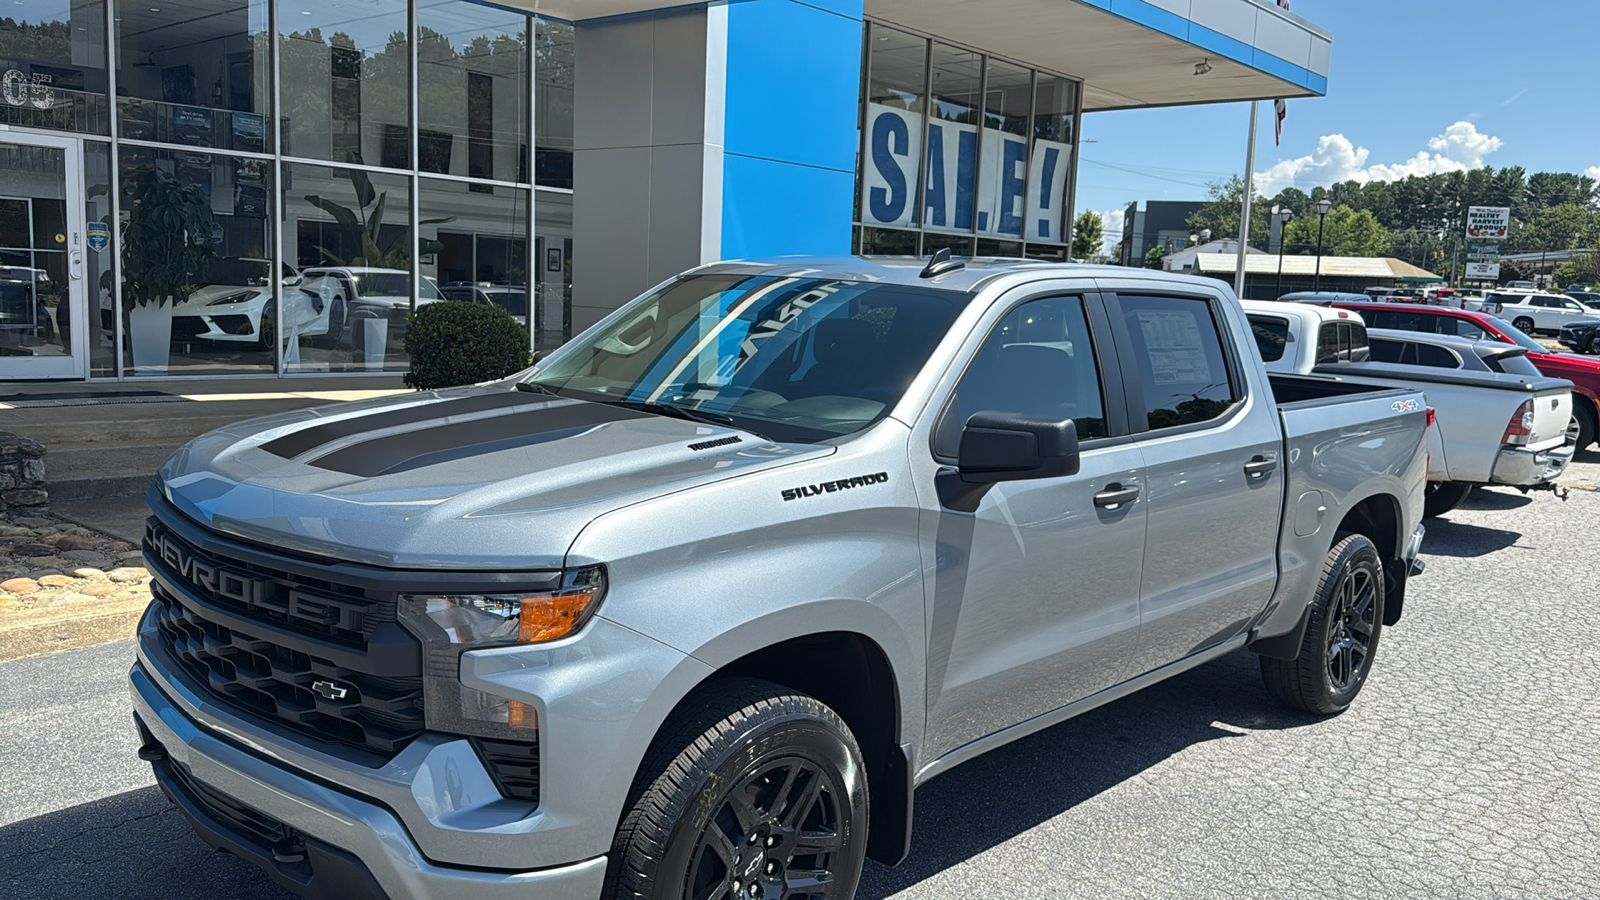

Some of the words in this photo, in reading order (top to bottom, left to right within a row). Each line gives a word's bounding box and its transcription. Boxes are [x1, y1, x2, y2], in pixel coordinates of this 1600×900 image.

[3, 69, 54, 109] 05
[869, 111, 1060, 238] SALE!
[687, 435, 743, 452] TURBOMAX
[781, 471, 889, 502] SILVERADO
[145, 518, 374, 632] CHEVROLET
